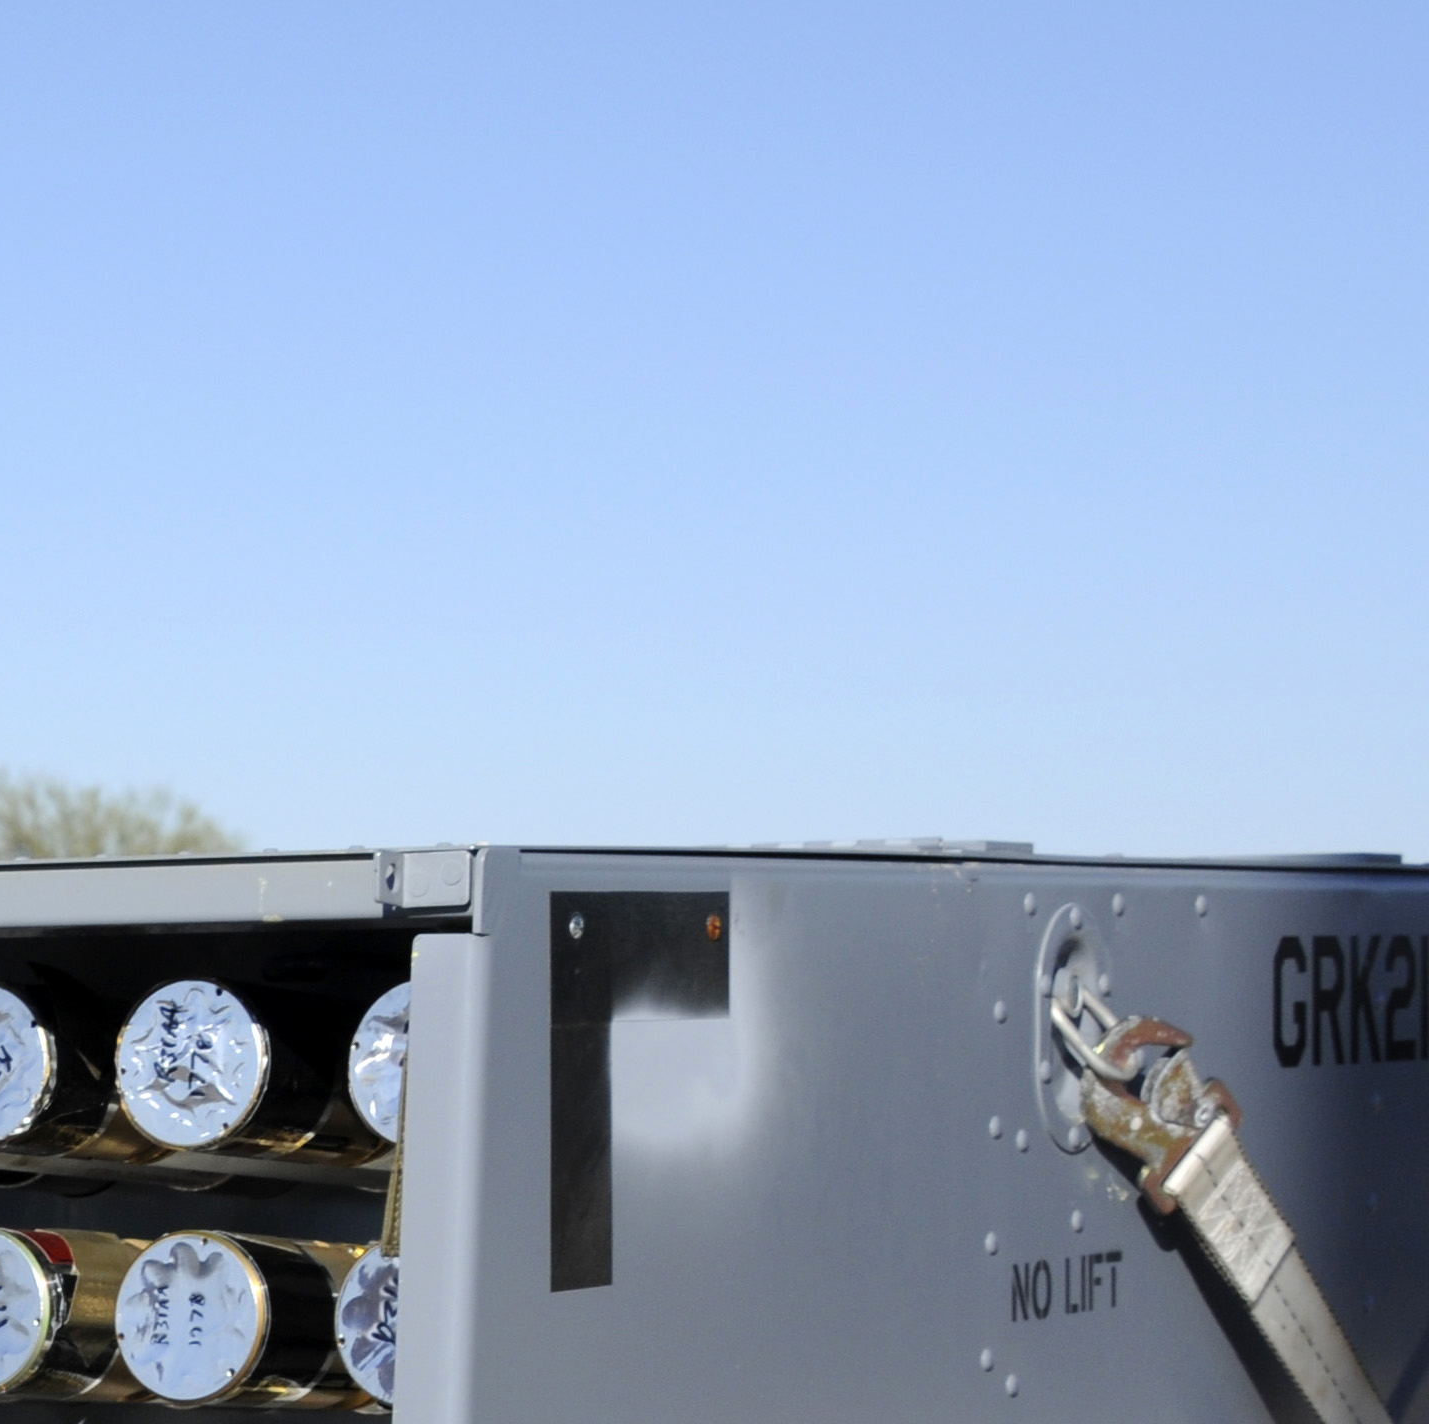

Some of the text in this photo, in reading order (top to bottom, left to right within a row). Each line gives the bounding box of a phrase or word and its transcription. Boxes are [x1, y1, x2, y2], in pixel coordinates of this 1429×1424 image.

[1273, 935, 1429, 1068] GRK21
[1011, 1250, 1124, 1323] NO LIFT
